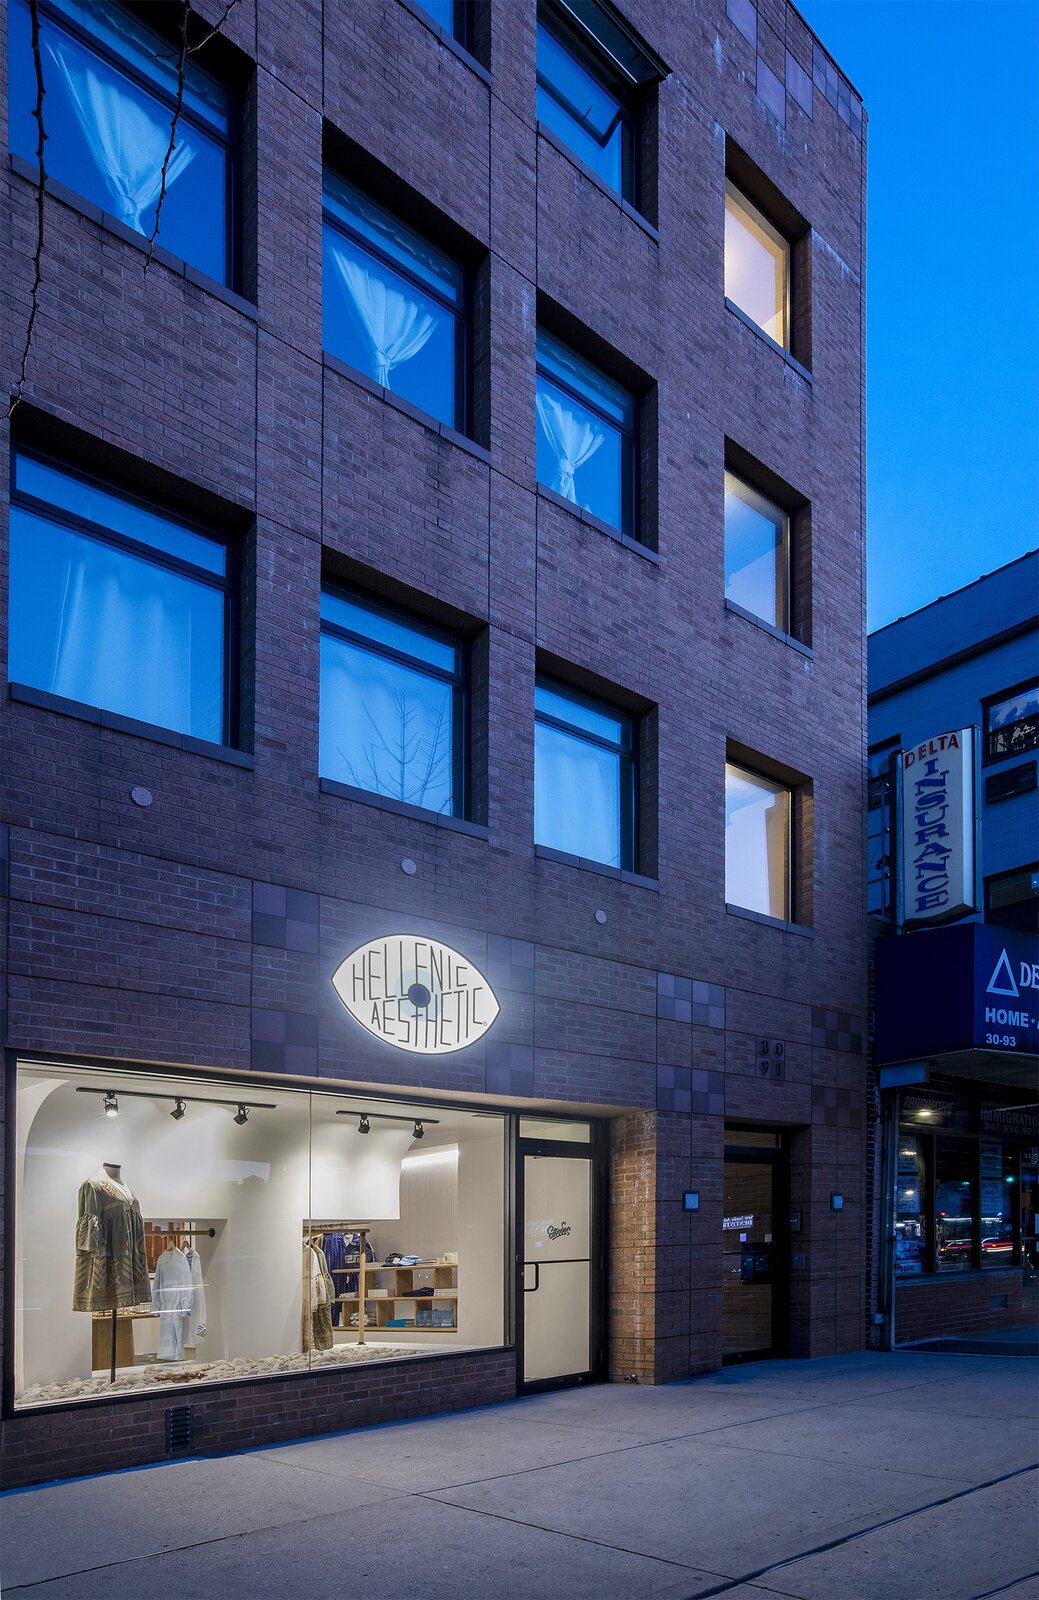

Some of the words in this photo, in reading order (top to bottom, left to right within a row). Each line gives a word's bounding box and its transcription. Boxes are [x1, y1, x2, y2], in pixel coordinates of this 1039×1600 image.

[905, 734, 959, 769] DELTA
[913, 757, 953, 913] INSURANCE
[352, 940, 468, 1002] HELLENIC
[371, 987, 483, 1049] AESTHETIC
[985, 1007, 1029, 1028] HOME
[760, 1040, 784, 1056] 30
[985, 1033, 1017, 1047] 30-93
[759, 1060, 781, 1077] 91
[980, 1108, 1039, 1127] IMMIGRATIO
